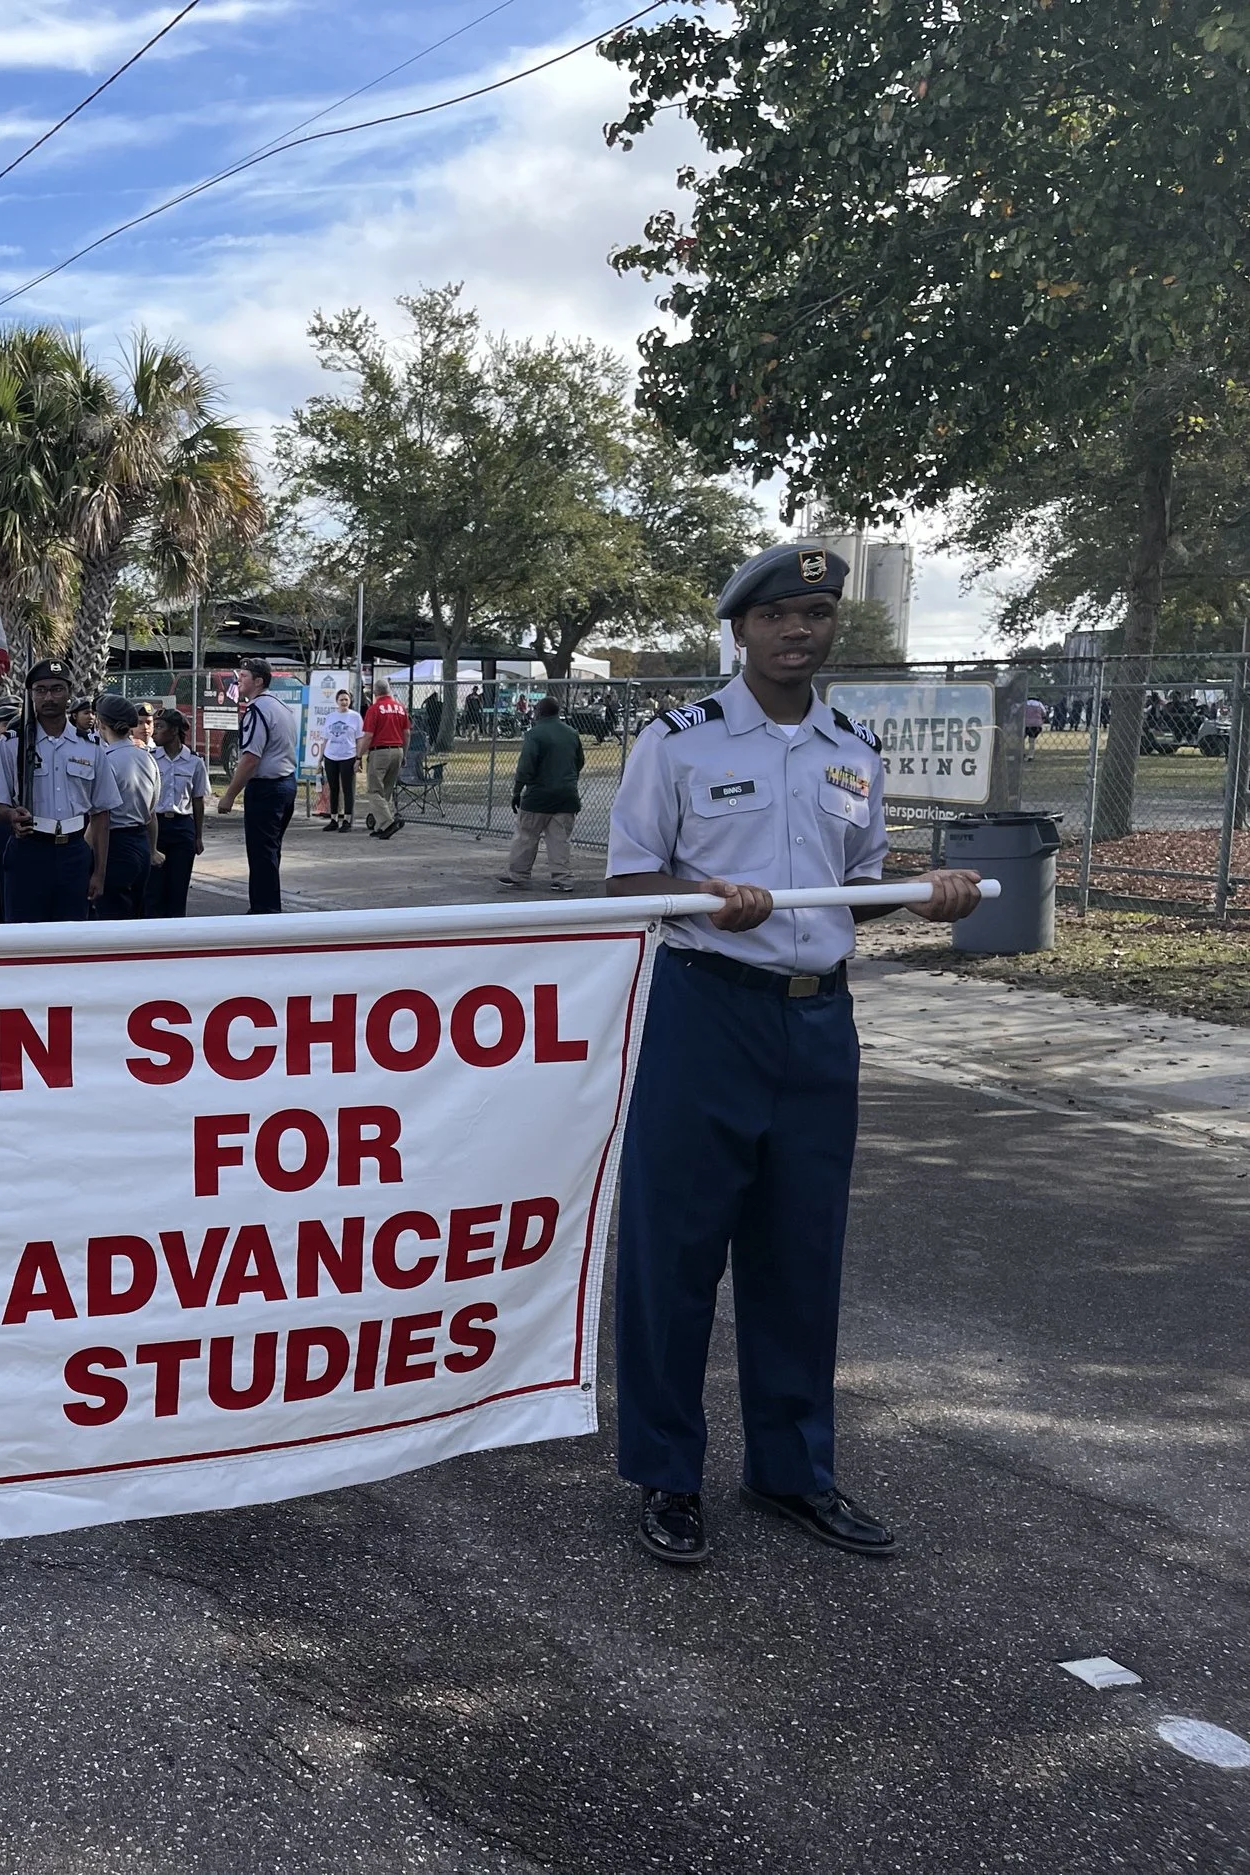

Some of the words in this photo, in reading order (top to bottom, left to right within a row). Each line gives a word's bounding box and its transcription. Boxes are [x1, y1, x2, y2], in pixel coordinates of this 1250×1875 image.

[861, 716, 983, 753] GATERS
[881, 757, 978, 776] RKING
[723, 785, 743, 796] BINNS
[126, 984, 588, 1086] SCHOOL
[193, 1105, 403, 1197] FOR
[1, 1196, 560, 1325] ADVANCED
[62, 1302, 498, 1426] STUDIES
